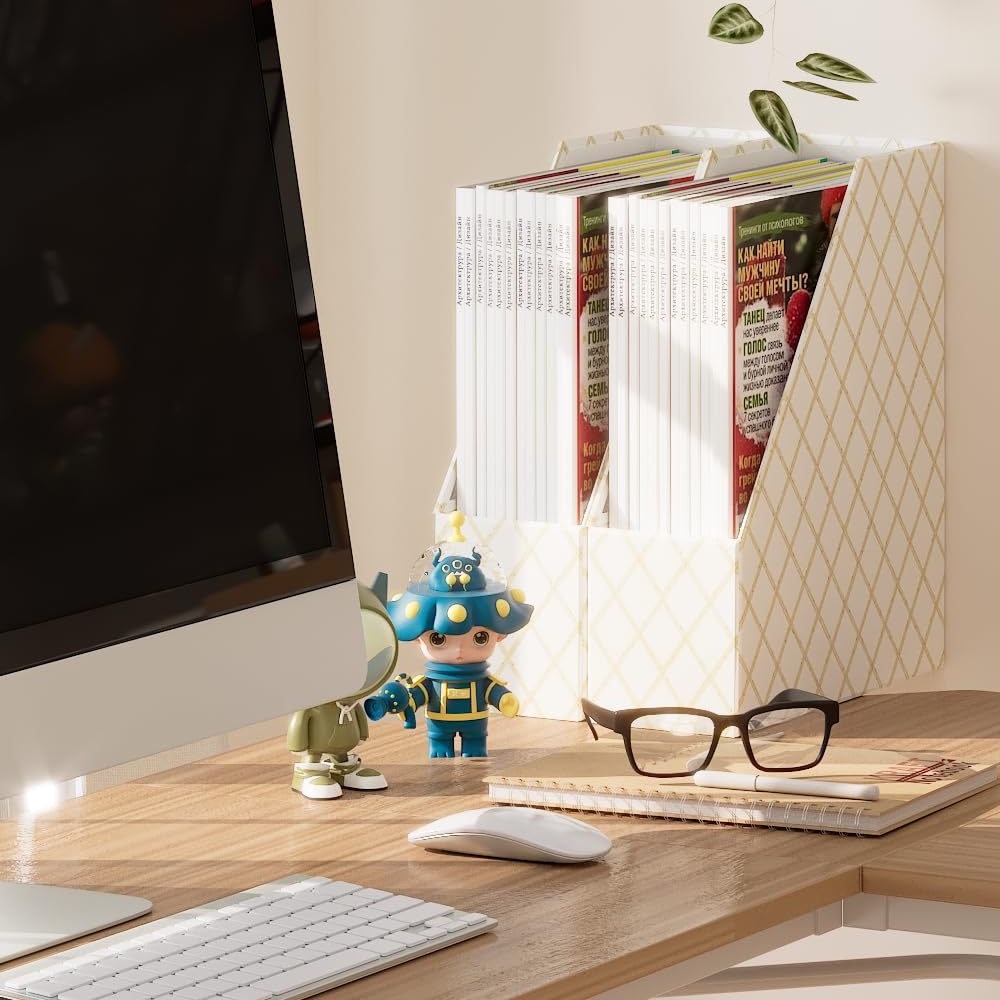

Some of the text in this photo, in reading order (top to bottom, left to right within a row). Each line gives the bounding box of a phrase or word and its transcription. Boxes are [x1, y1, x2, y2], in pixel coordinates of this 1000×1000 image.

[738, 239, 785, 265] КАК НАЙТИ
[738, 259, 780, 283] МУЖЧИНУ
[738, 273, 808, 303] СВОЕЙ МЕЧТЫ?
[743, 308, 765, 326] ТАНЕЦ
[743, 338, 767, 356] ГОЛОС
[743, 392, 768, 410] СЕМЬЯ
